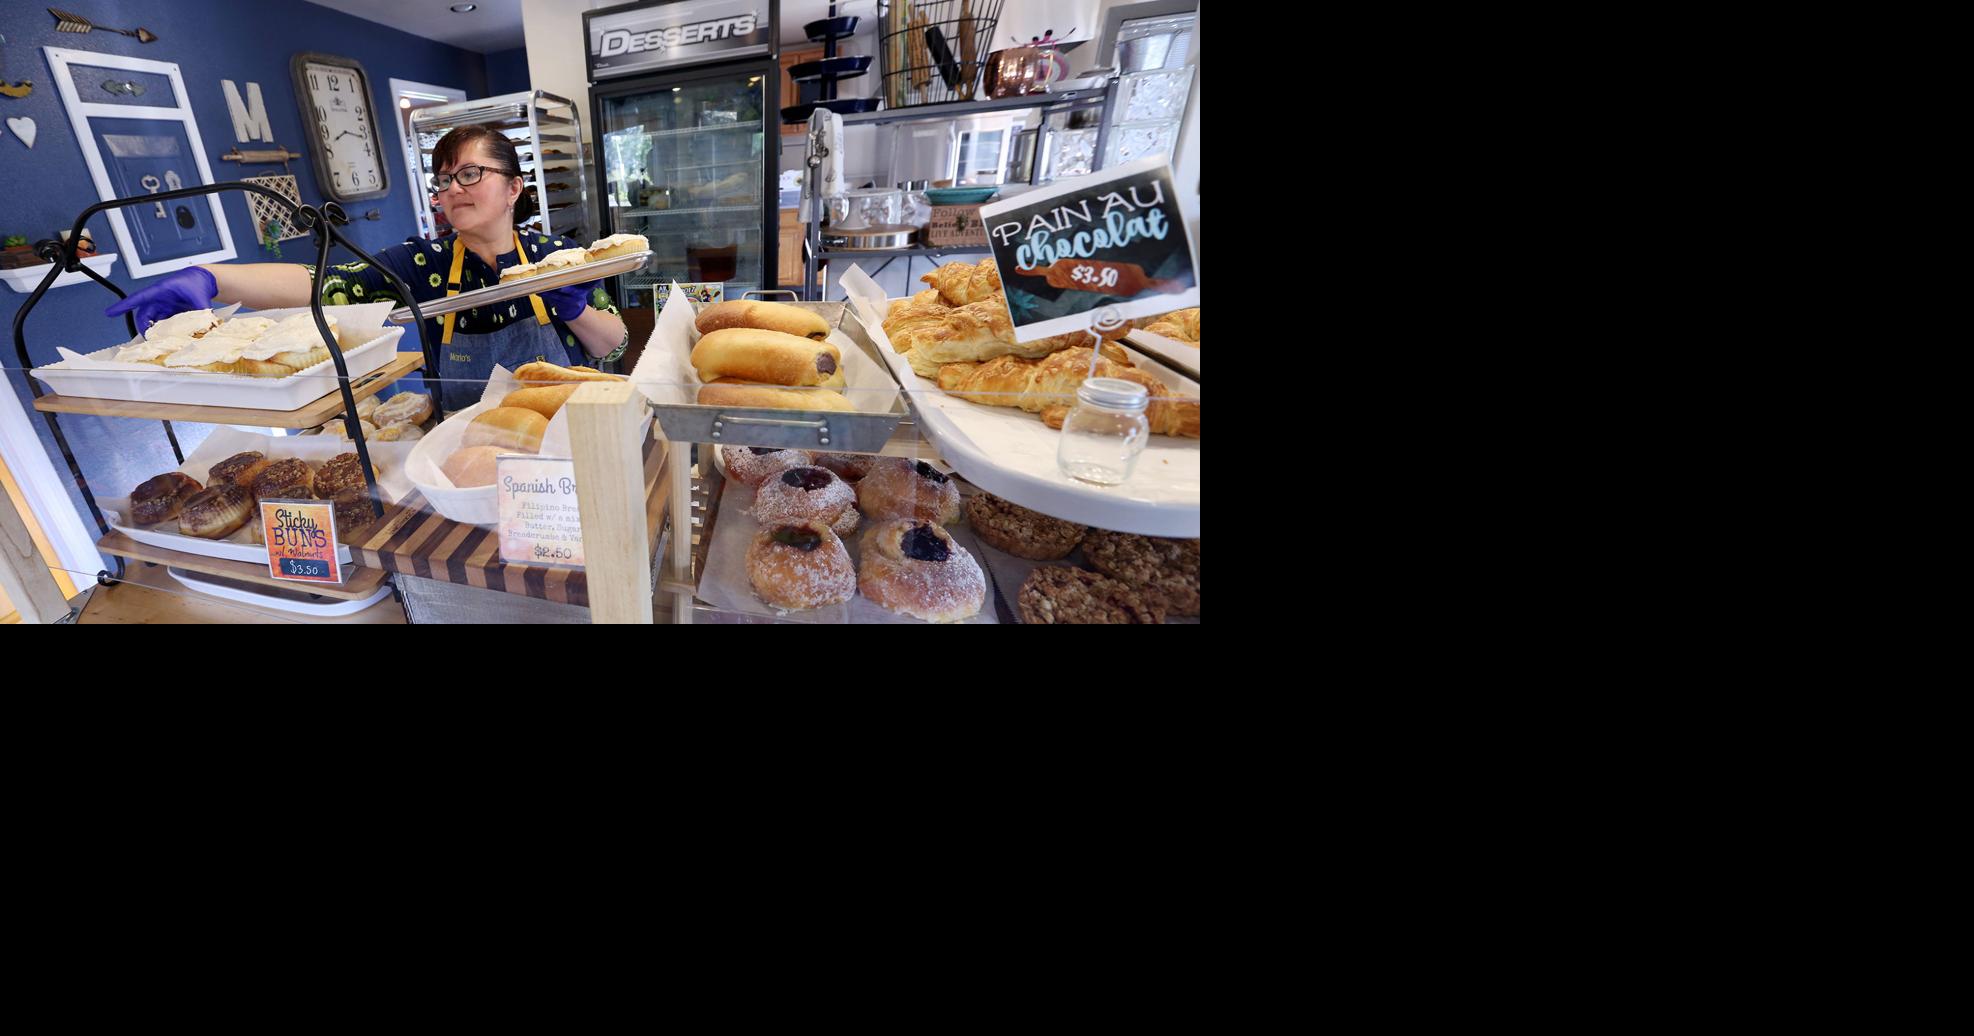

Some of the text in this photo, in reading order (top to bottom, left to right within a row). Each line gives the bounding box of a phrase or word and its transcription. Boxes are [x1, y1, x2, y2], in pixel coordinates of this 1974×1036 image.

[600, 13, 757, 57] DESSERTS
[309, 74, 319, 91] 11
[327, 74, 339, 91] 12
[349, 77, 354, 93] 1
[220, 79, 274, 143] M
[355, 106, 363, 121] 2
[321, 125, 330, 140] 9
[359, 125, 368, 140] 3
[324, 144, 334, 160] 8
[363, 142, 372, 156] 4
[333, 172, 341, 187] 7
[351, 171, 360, 187] 6
[368, 169, 376, 184] 5
[992, 180, 1165, 246] PAIN AU
[1016, 208, 1168, 271] chocolat
[1071, 264, 1118, 287] $3.50
[503, 475, 577, 499] Spanish Br
[521, 502, 578, 512] Filipino Bre
[275, 508, 317, 538] Sticky
[516, 511, 544, 520] Filled
[272, 527, 327, 548] BUNS
[534, 542, 572, 559] $2.50
[289, 559, 319, 575] $3.50
